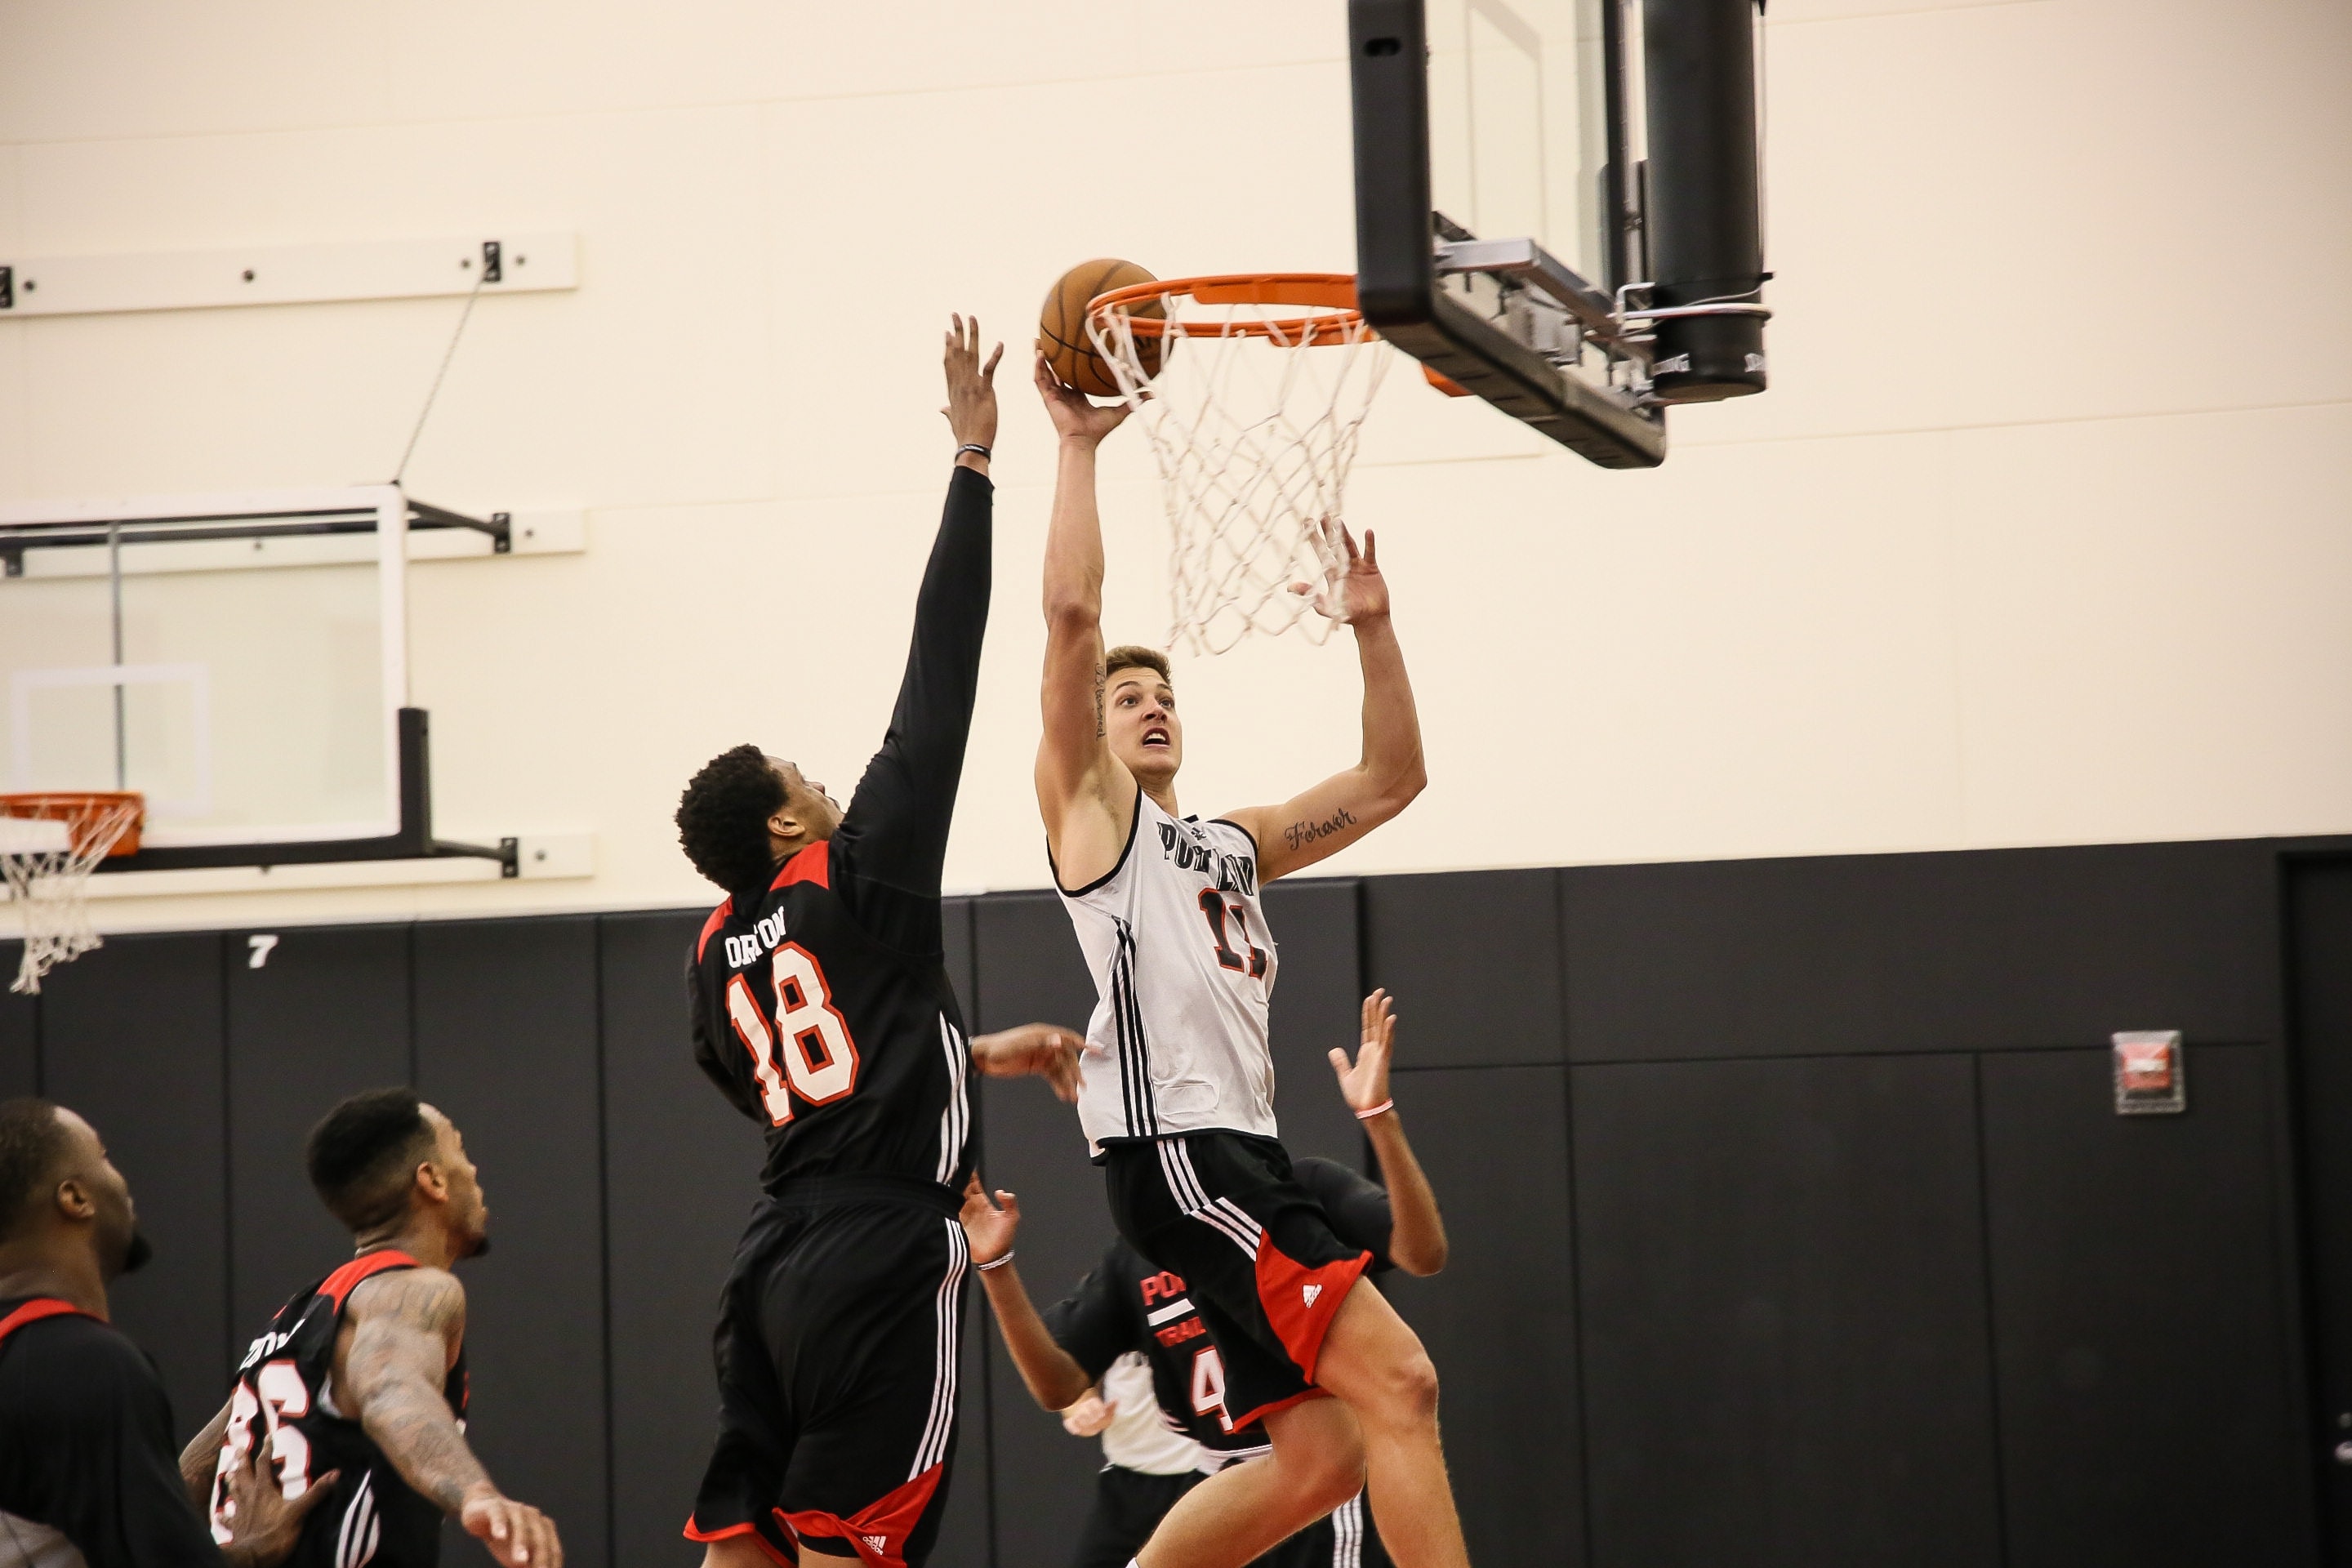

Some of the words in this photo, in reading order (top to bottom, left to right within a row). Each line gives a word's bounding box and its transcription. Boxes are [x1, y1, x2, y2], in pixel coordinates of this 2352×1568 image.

[248, 934, 279, 969] 7
[1198, 887, 1267, 980] 11
[725, 940, 860, 1127] 18
[1191, 1344, 1234, 1435] 4
